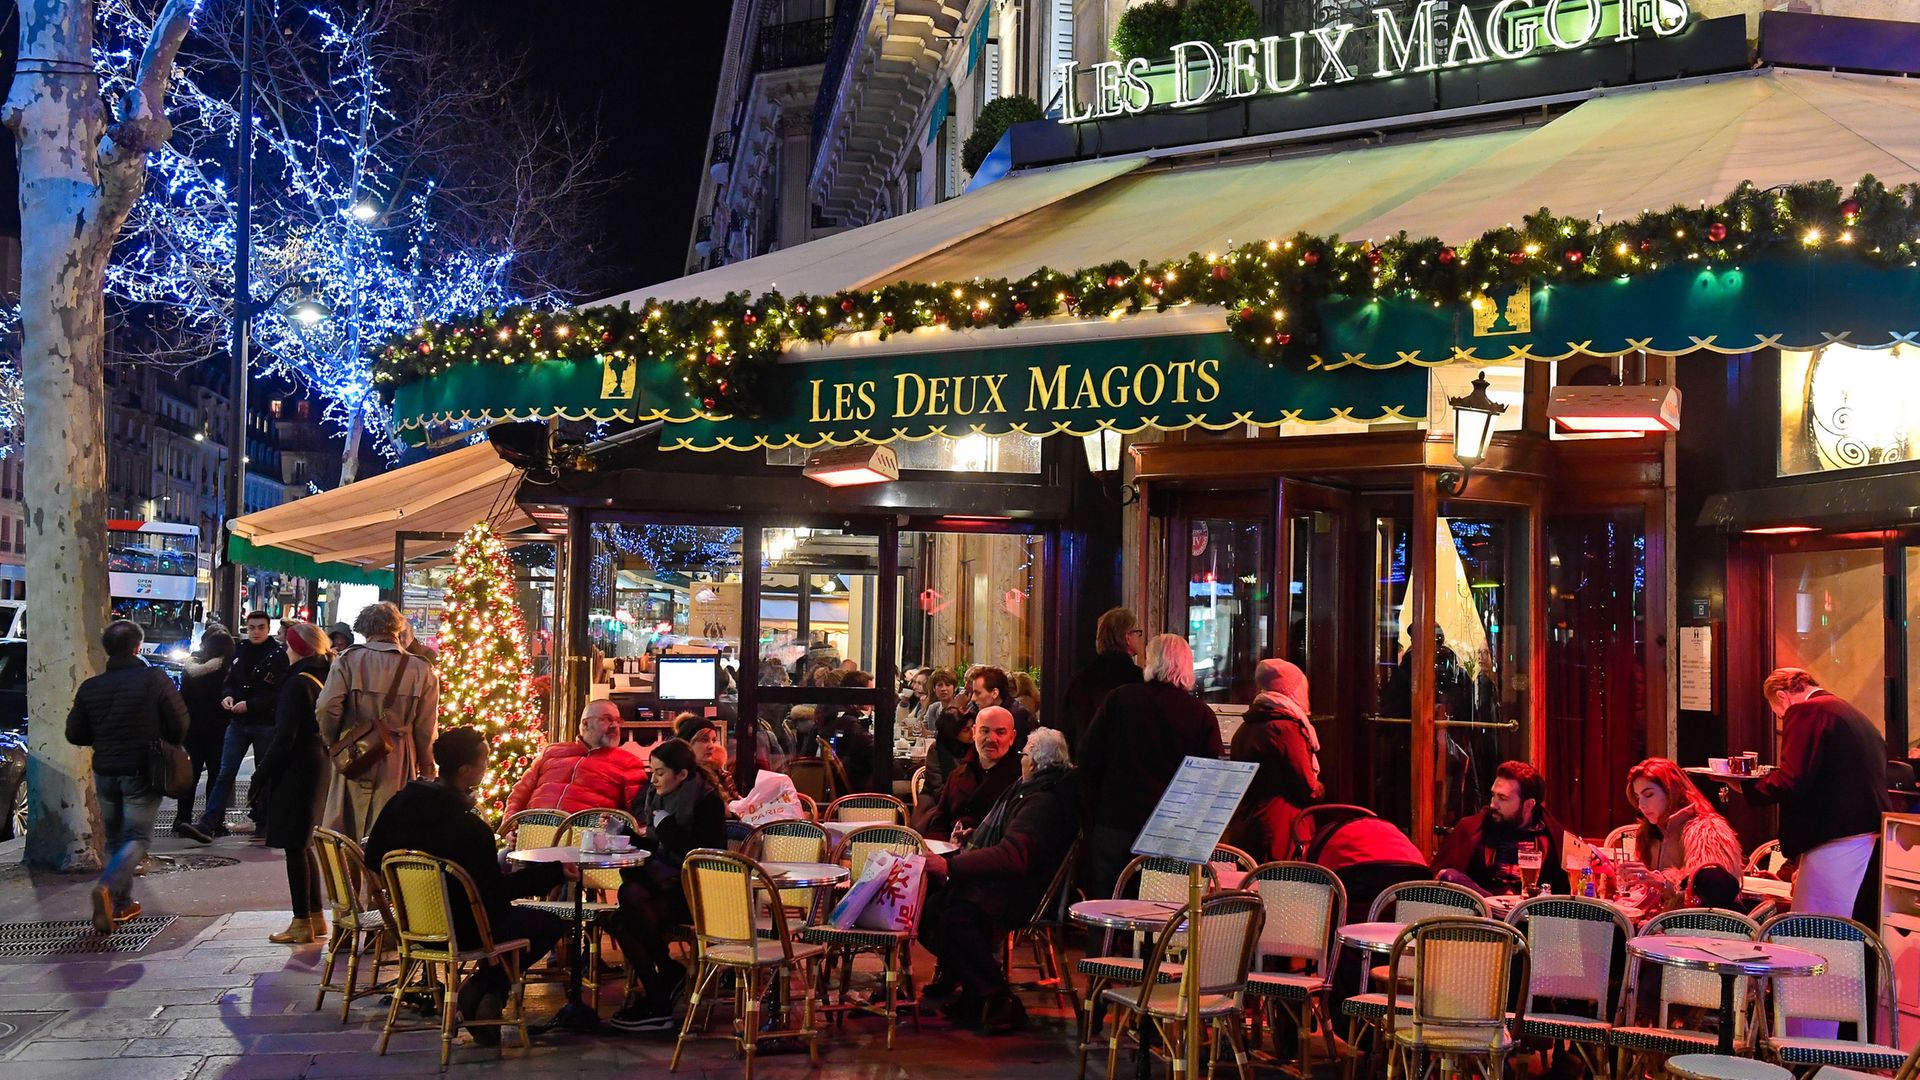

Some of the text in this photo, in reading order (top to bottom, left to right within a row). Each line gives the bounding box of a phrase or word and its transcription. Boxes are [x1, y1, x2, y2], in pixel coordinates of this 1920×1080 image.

[1057, 0, 1690, 123] LES DEUX MAGOTS
[809, 359, 1220, 422] LES DEUX MAGOTS
